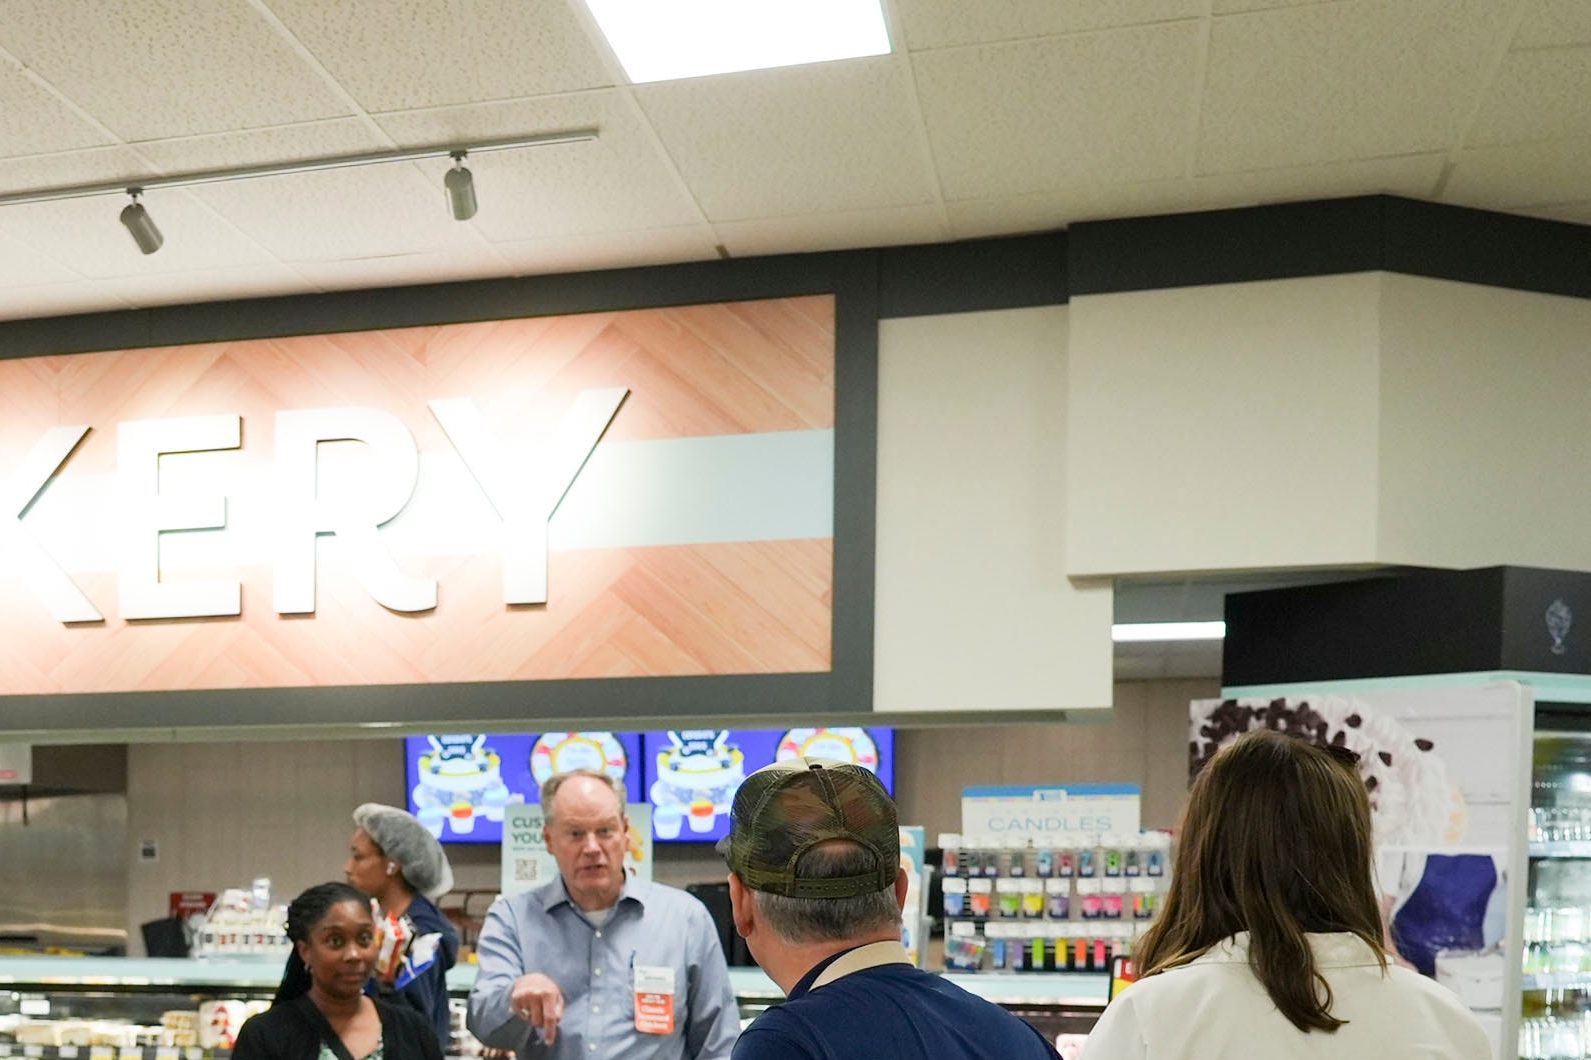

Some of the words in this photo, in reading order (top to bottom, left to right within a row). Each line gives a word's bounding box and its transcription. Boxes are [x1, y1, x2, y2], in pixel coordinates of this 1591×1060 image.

[512, 816, 542, 829] CUS
[987, 816, 1113, 832] CANDLES
[512, 833, 545, 844] YOU
